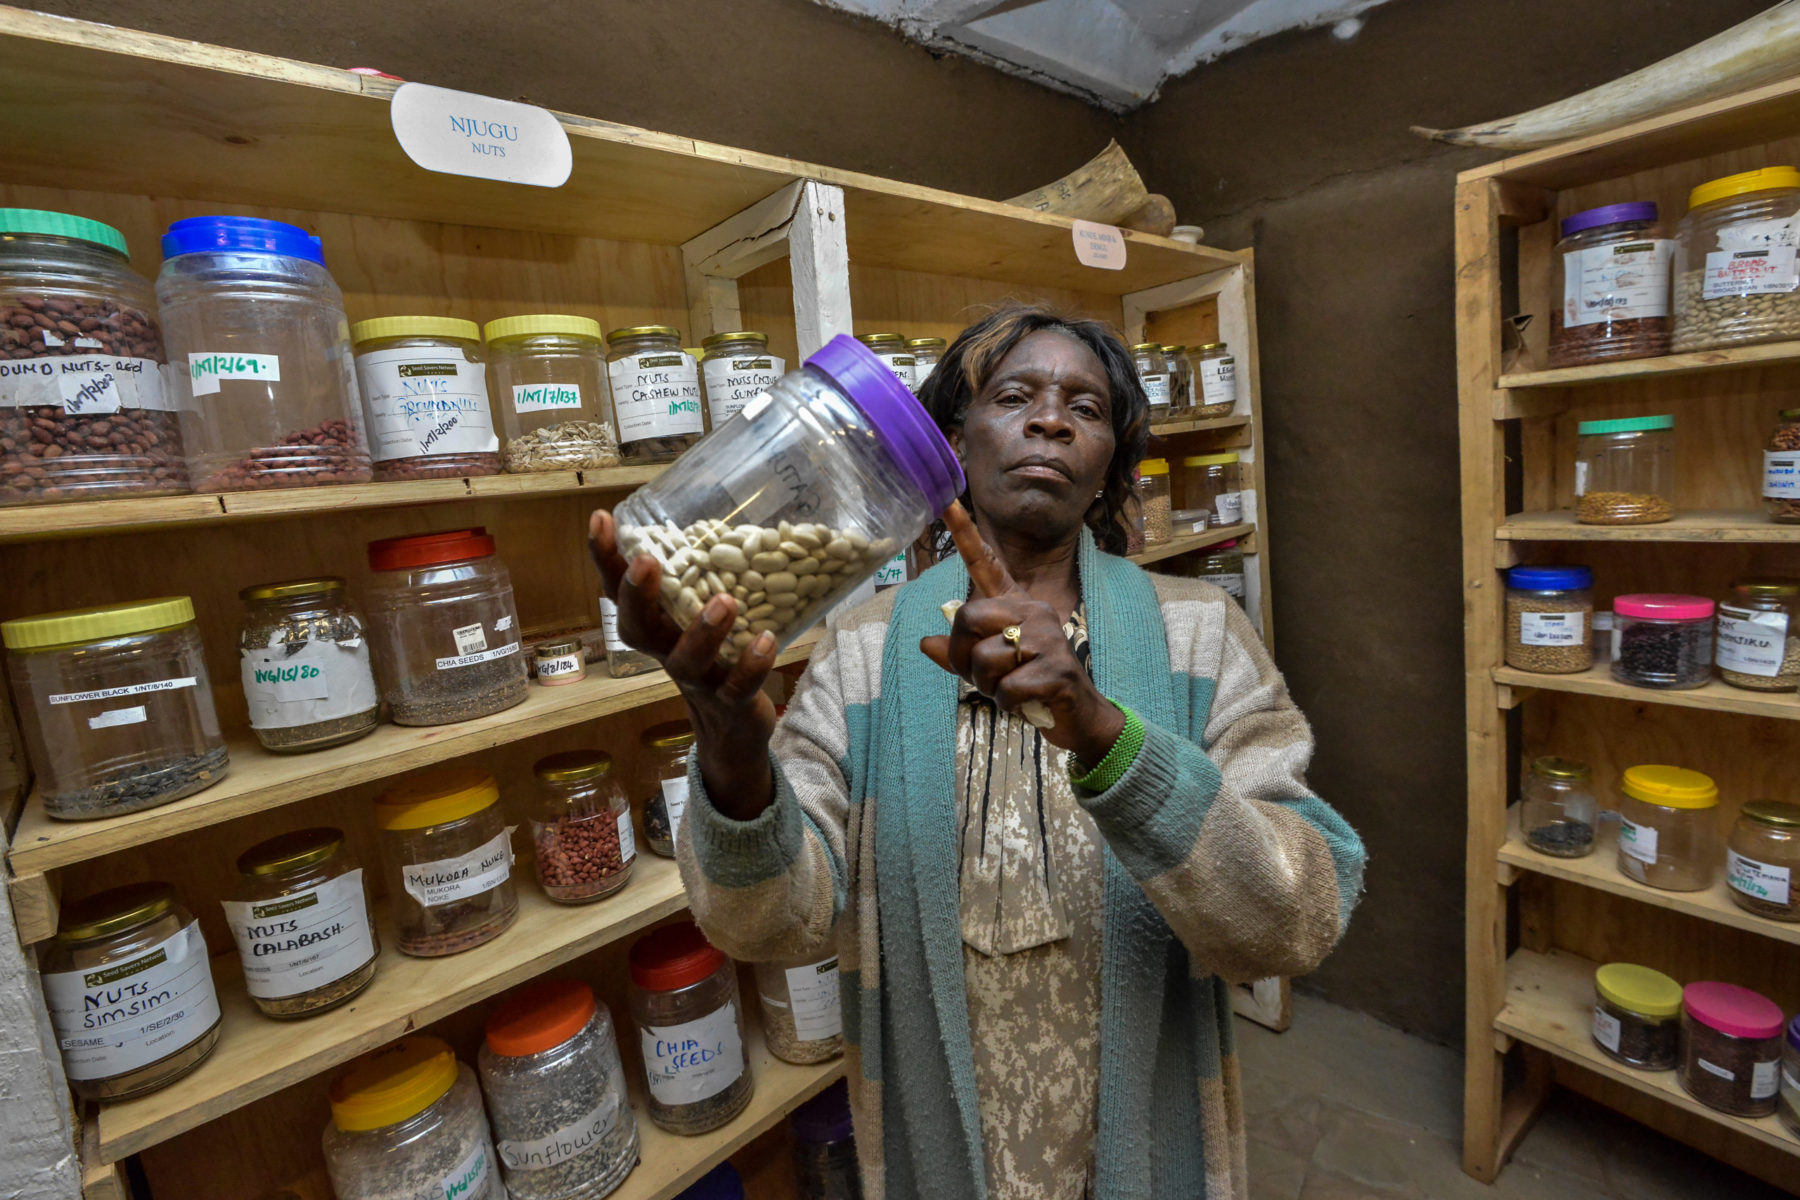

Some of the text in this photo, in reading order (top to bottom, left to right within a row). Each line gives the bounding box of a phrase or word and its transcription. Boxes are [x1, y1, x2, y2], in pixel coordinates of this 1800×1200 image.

[449, 115, 518, 142] NJUGU
[472, 142, 506, 157] NUTS
[637, 373, 669, 387] NUTS
[727, 376, 751, 387] NUTS
[517, 387, 578, 405] 1/NT/7/137
[632, 388, 679, 402] CASHEW
[437, 660, 457, 668] CHIA
[458, 653, 485, 665] SEEDS
[51, 691, 101, 703] SUNFLOWER
[102, 687, 130, 697] BLACK
[247, 920, 298, 940] NUTS
[83, 981, 149, 1013] NUTS
[63, 1010, 185, 1049] SESAME 1/SE/2/30
[655, 1039, 699, 1058] CHIA
[672, 1041, 724, 1070] SEEDS
[504, 1105, 616, 1166] Sunflower
